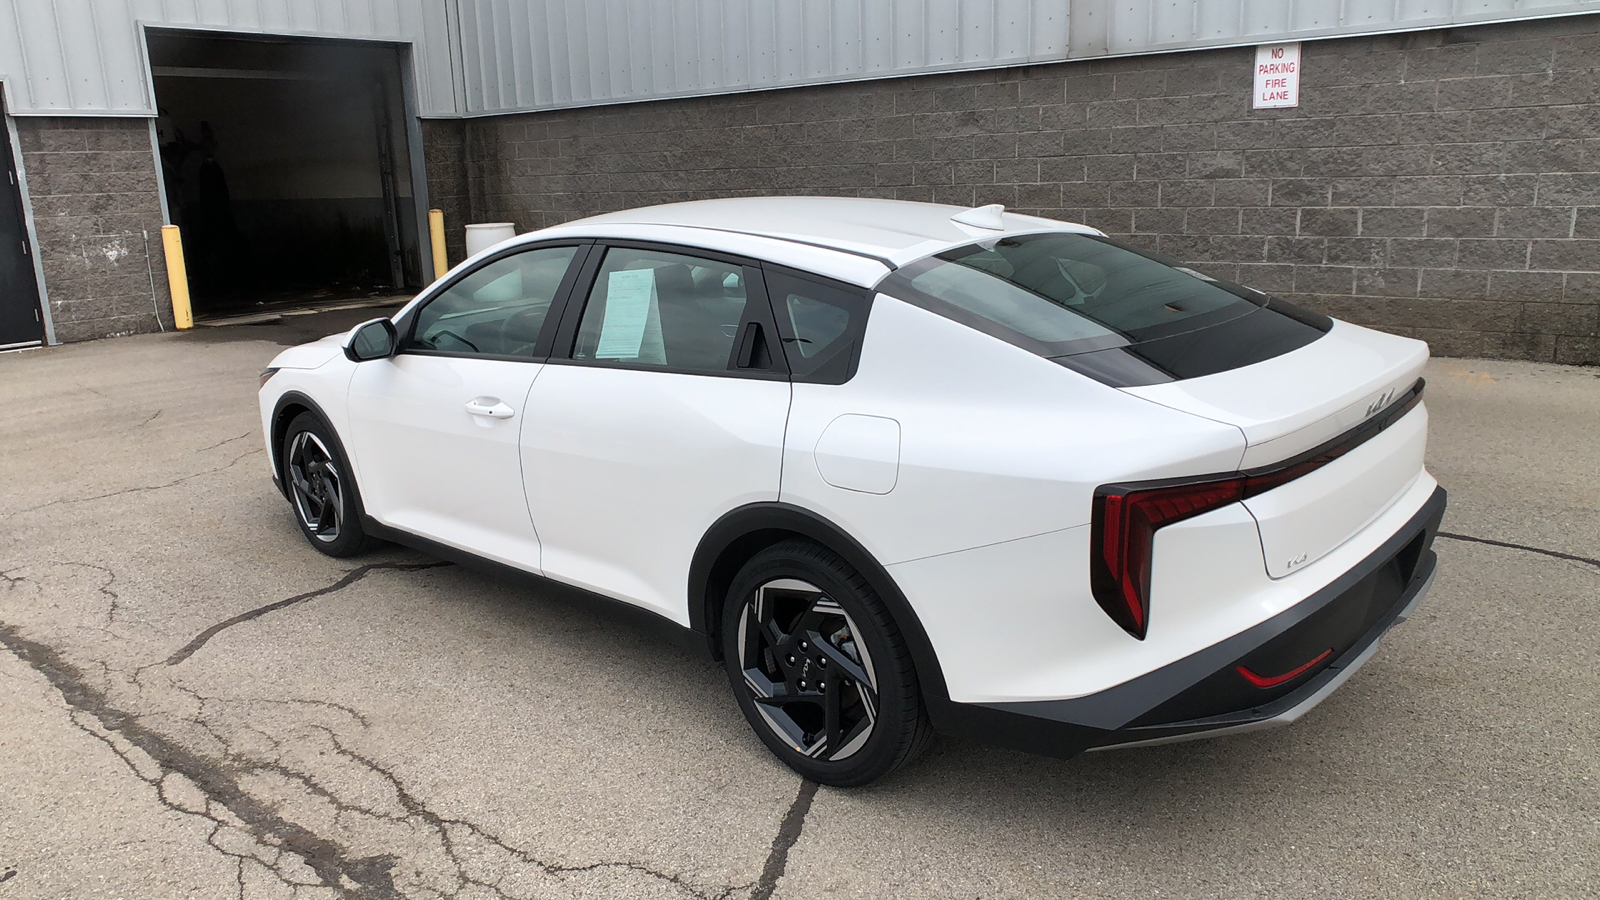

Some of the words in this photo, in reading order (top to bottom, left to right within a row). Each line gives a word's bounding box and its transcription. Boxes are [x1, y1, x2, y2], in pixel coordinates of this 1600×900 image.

[1271, 47, 1284, 59] NO
[1258, 62, 1295, 75] PARKING
[1265, 78, 1287, 88] FIRE
[1262, 91, 1289, 101] LANE
